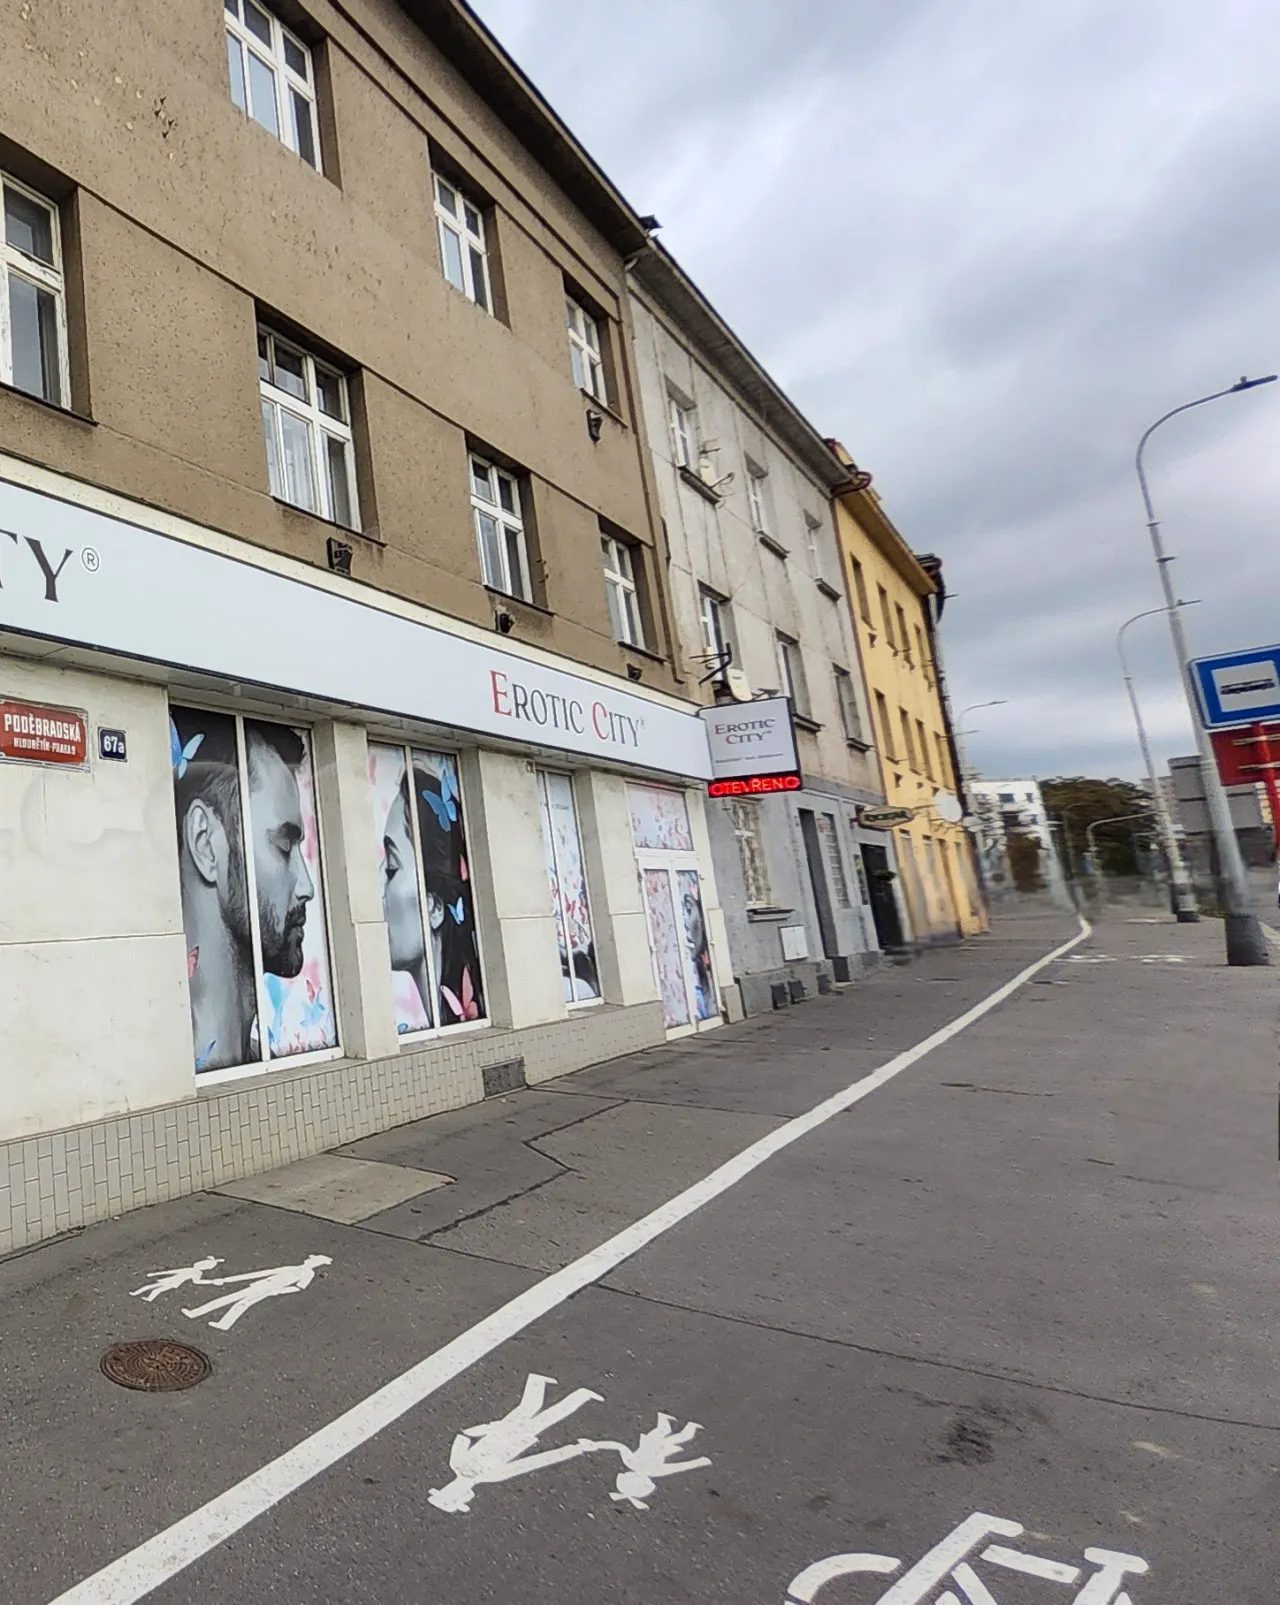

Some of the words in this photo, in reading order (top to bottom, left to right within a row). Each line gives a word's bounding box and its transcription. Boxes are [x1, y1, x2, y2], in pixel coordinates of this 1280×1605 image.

[490, 670, 584, 734] EROTIC
[4, 713, 81, 742] PODĚBRADSKÁ
[714, 719, 776, 734] EROTIC
[104, 735, 125, 753] 67a
[725, 730, 772, 744] CITY
